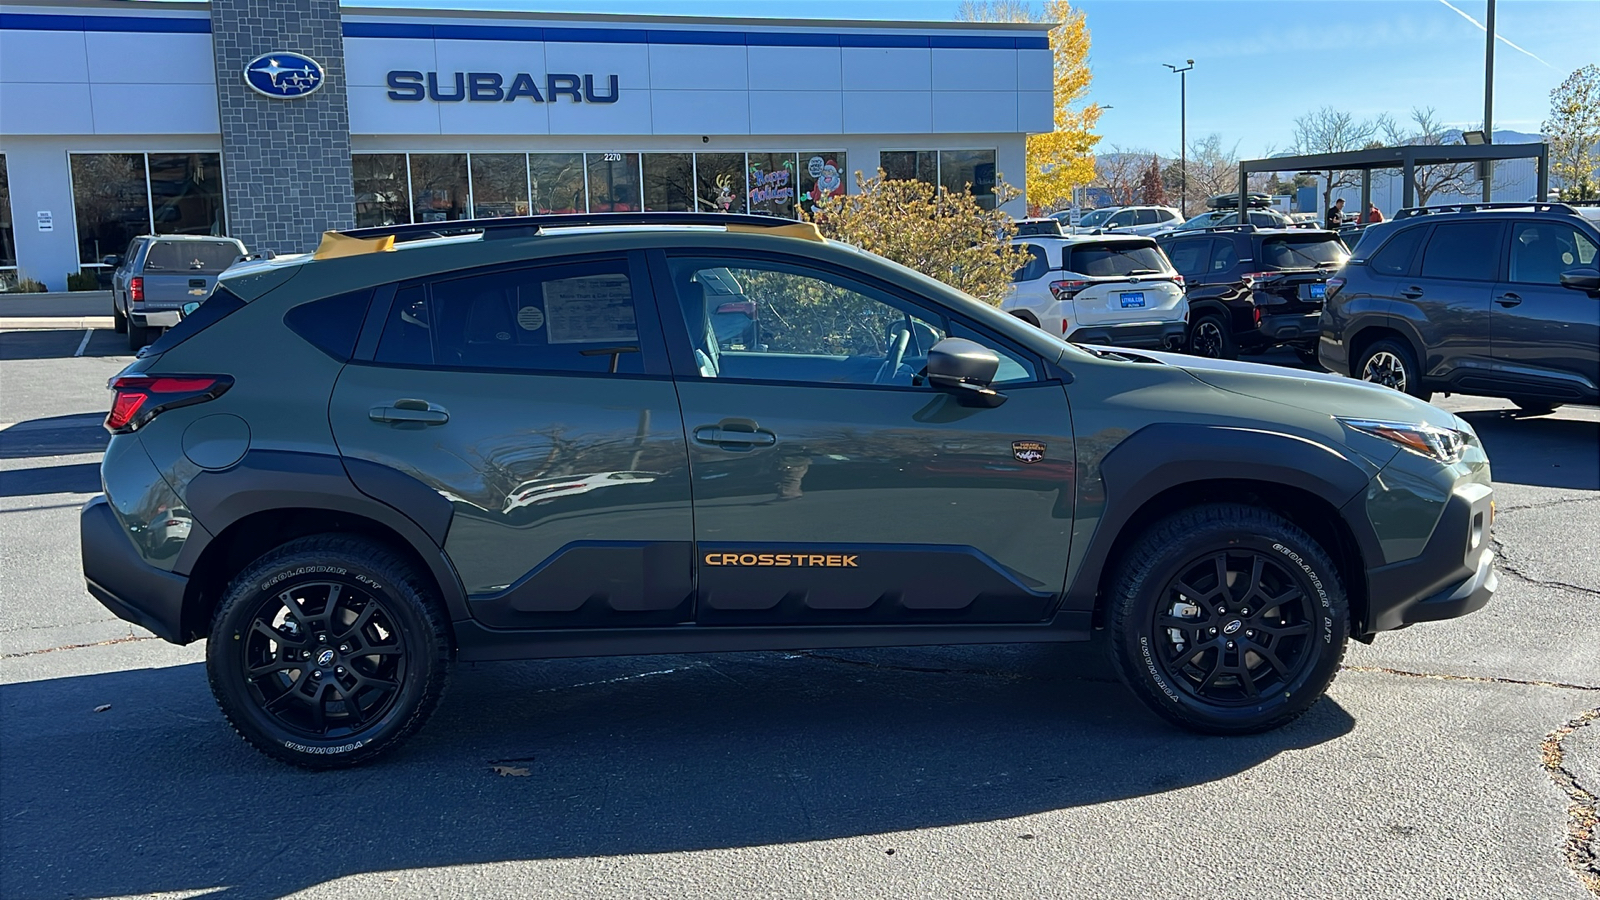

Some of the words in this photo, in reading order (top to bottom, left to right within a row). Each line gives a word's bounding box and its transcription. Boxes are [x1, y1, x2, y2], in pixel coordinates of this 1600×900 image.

[386, 70, 620, 104] SUBARU
[604, 153, 622, 162] 2270
[753, 169, 791, 188] Happy
[749, 185, 794, 205] Holidays
[705, 553, 858, 567] CROSSTREK
[261, 566, 347, 591] GEOLANDAR
[355, 574, 382, 590] A/T
[1272, 543, 1330, 608] GEOLANDAR
[1324, 616, 1332, 644] A/T
[1140, 636, 1179, 703] YOKOHAMA
[285, 740, 363, 755] YOKOHAMA
